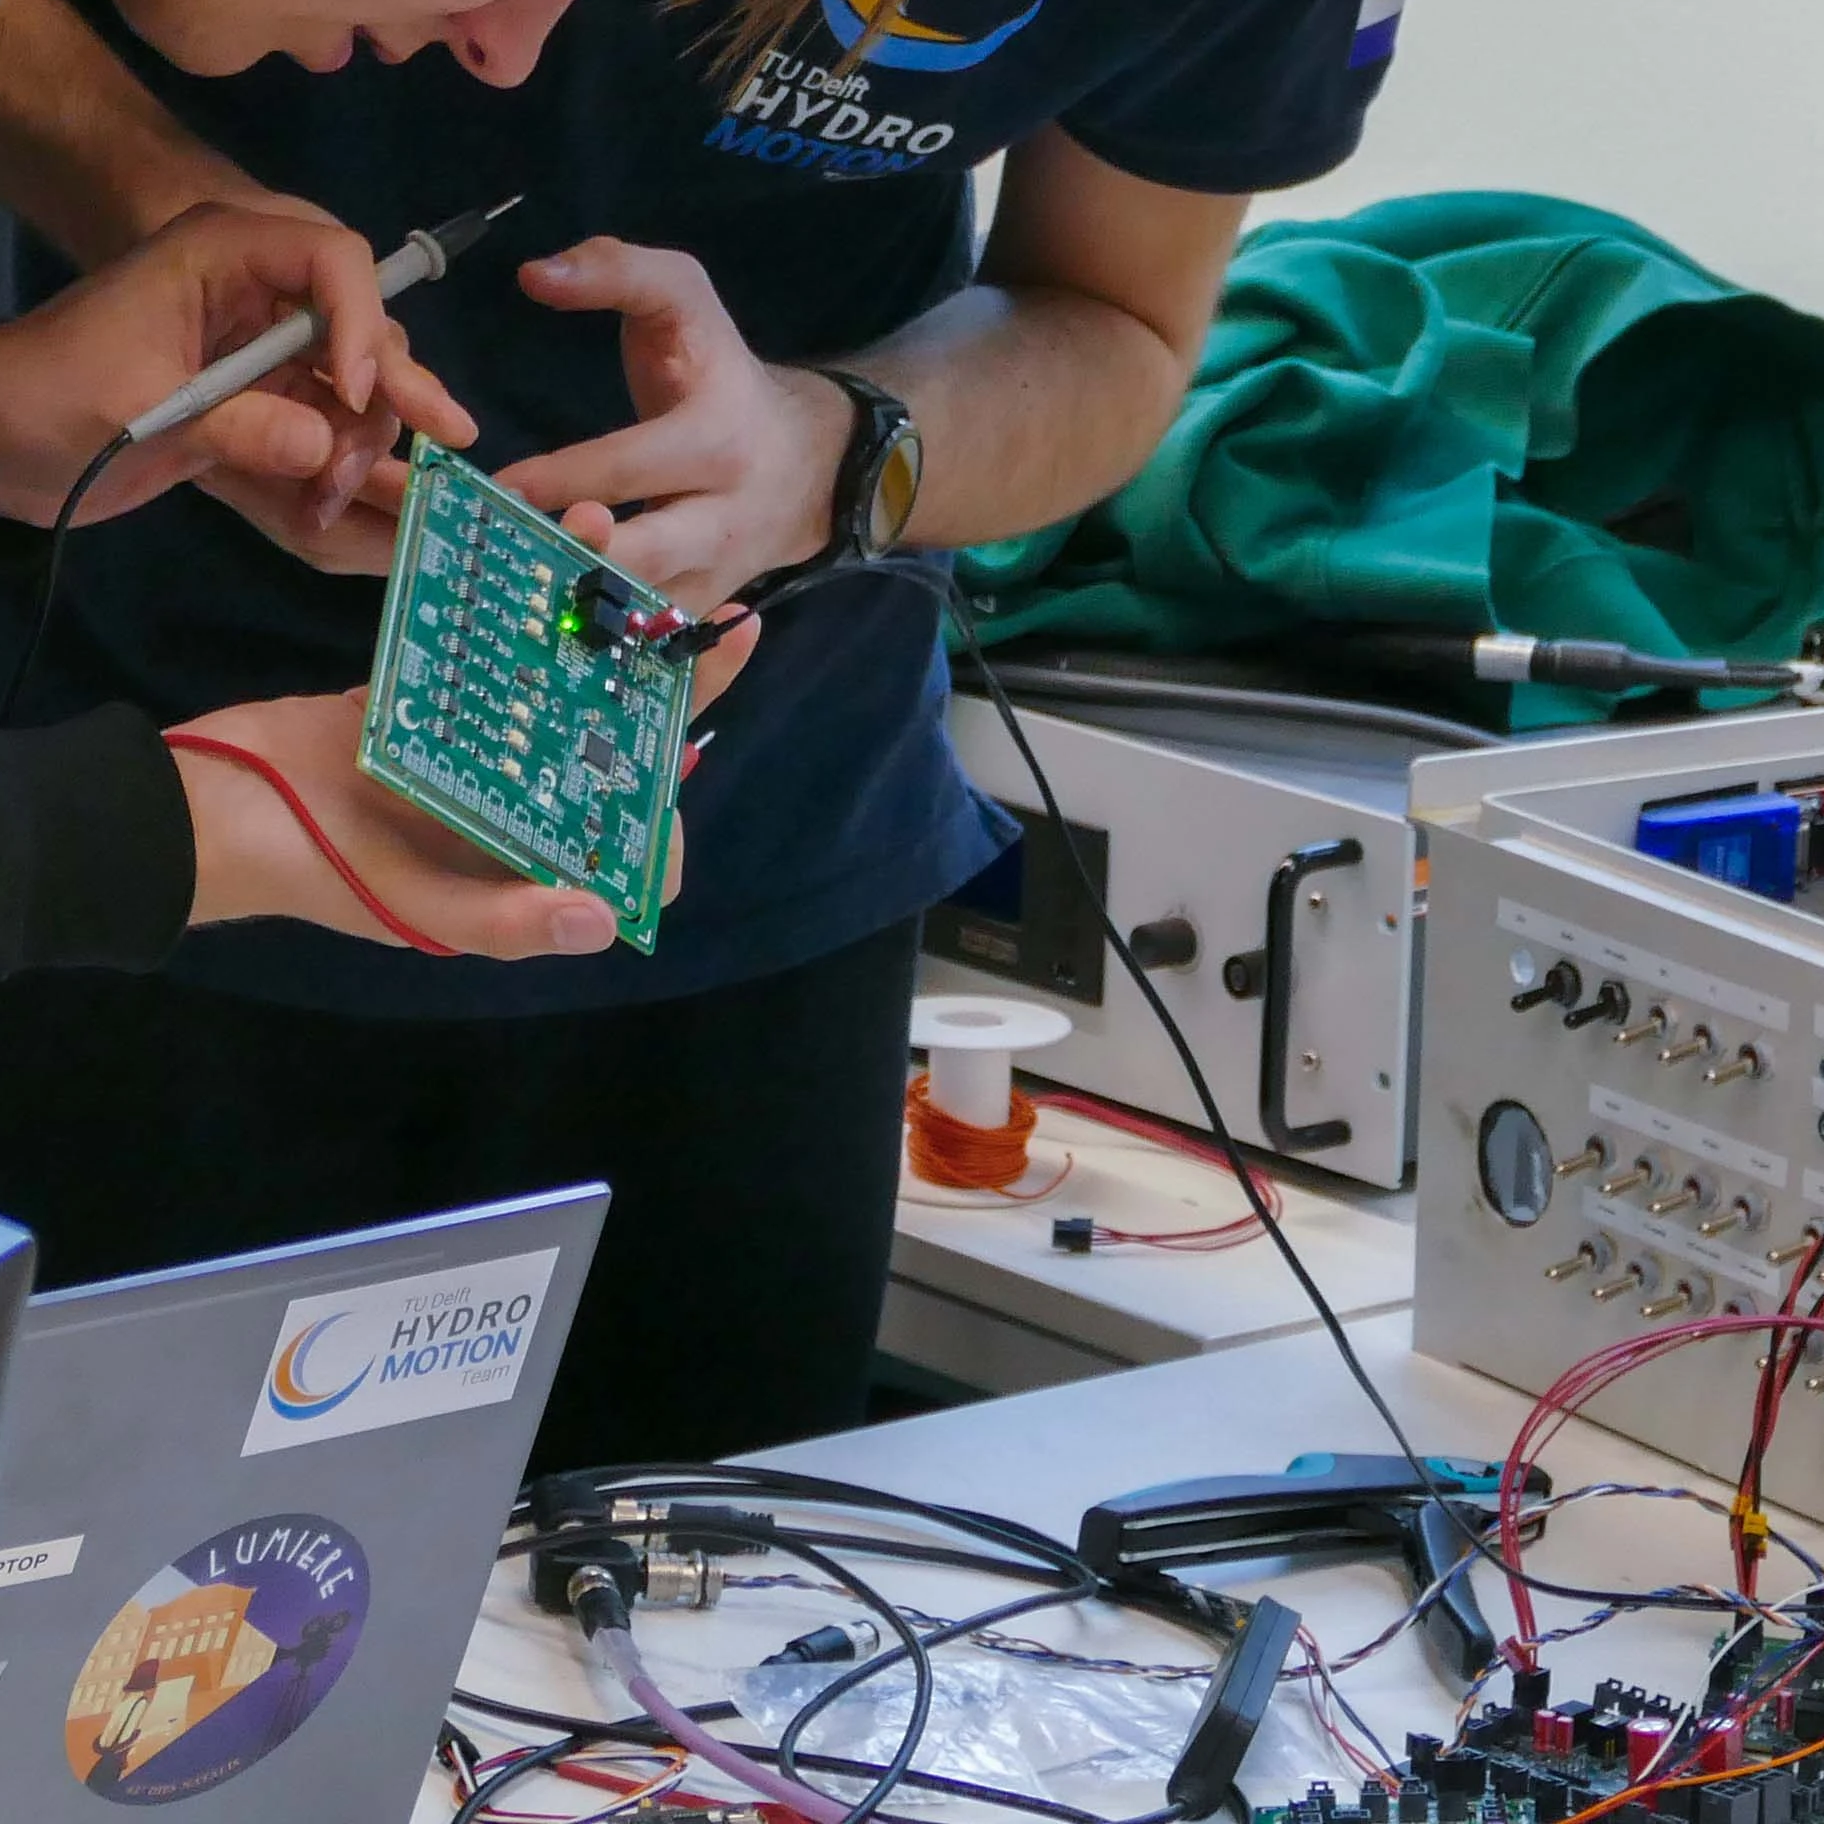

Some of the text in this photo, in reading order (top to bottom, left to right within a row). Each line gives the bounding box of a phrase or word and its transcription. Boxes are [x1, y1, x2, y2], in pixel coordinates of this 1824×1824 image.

[761, 49, 871, 102] TU Delft
[703, 116, 928, 173] MOTION
[731, 77, 955, 155] HYDRO
[389, 1293, 532, 1350] HYDRO
[404, 1286, 472, 1314] TU Delft
[378, 1326, 523, 1385] MOTION
[460, 1364, 512, 1388] Team
